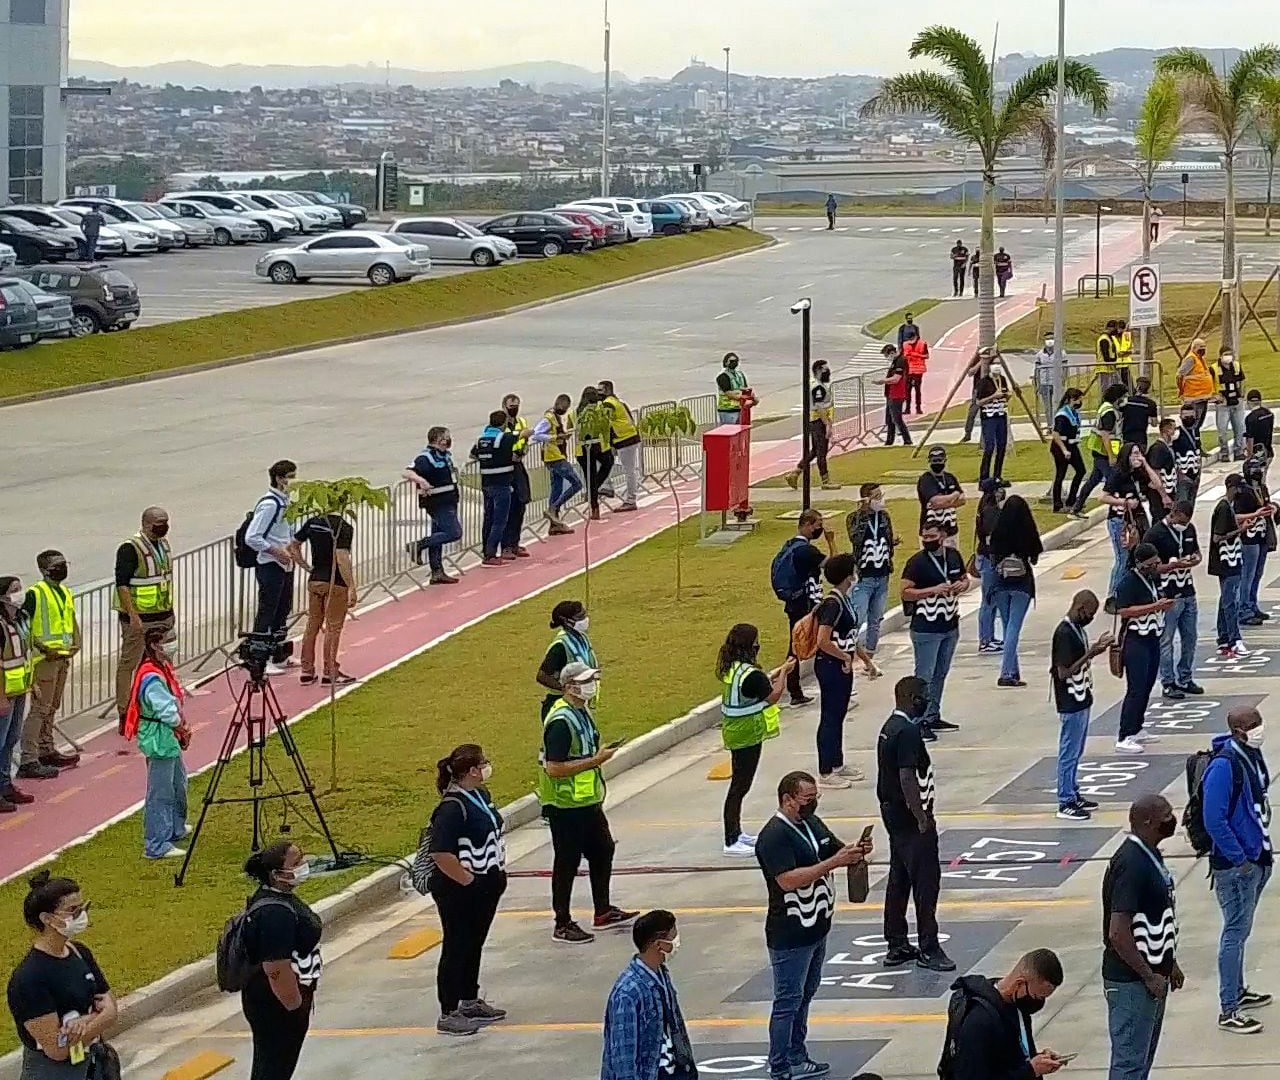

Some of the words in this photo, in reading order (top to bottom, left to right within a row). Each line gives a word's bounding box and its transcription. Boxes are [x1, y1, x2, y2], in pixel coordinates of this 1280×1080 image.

[1142, 700, 1221, 730] A55
[1043, 761, 1149, 797] A56
[940, 837, 1061, 882] A57
